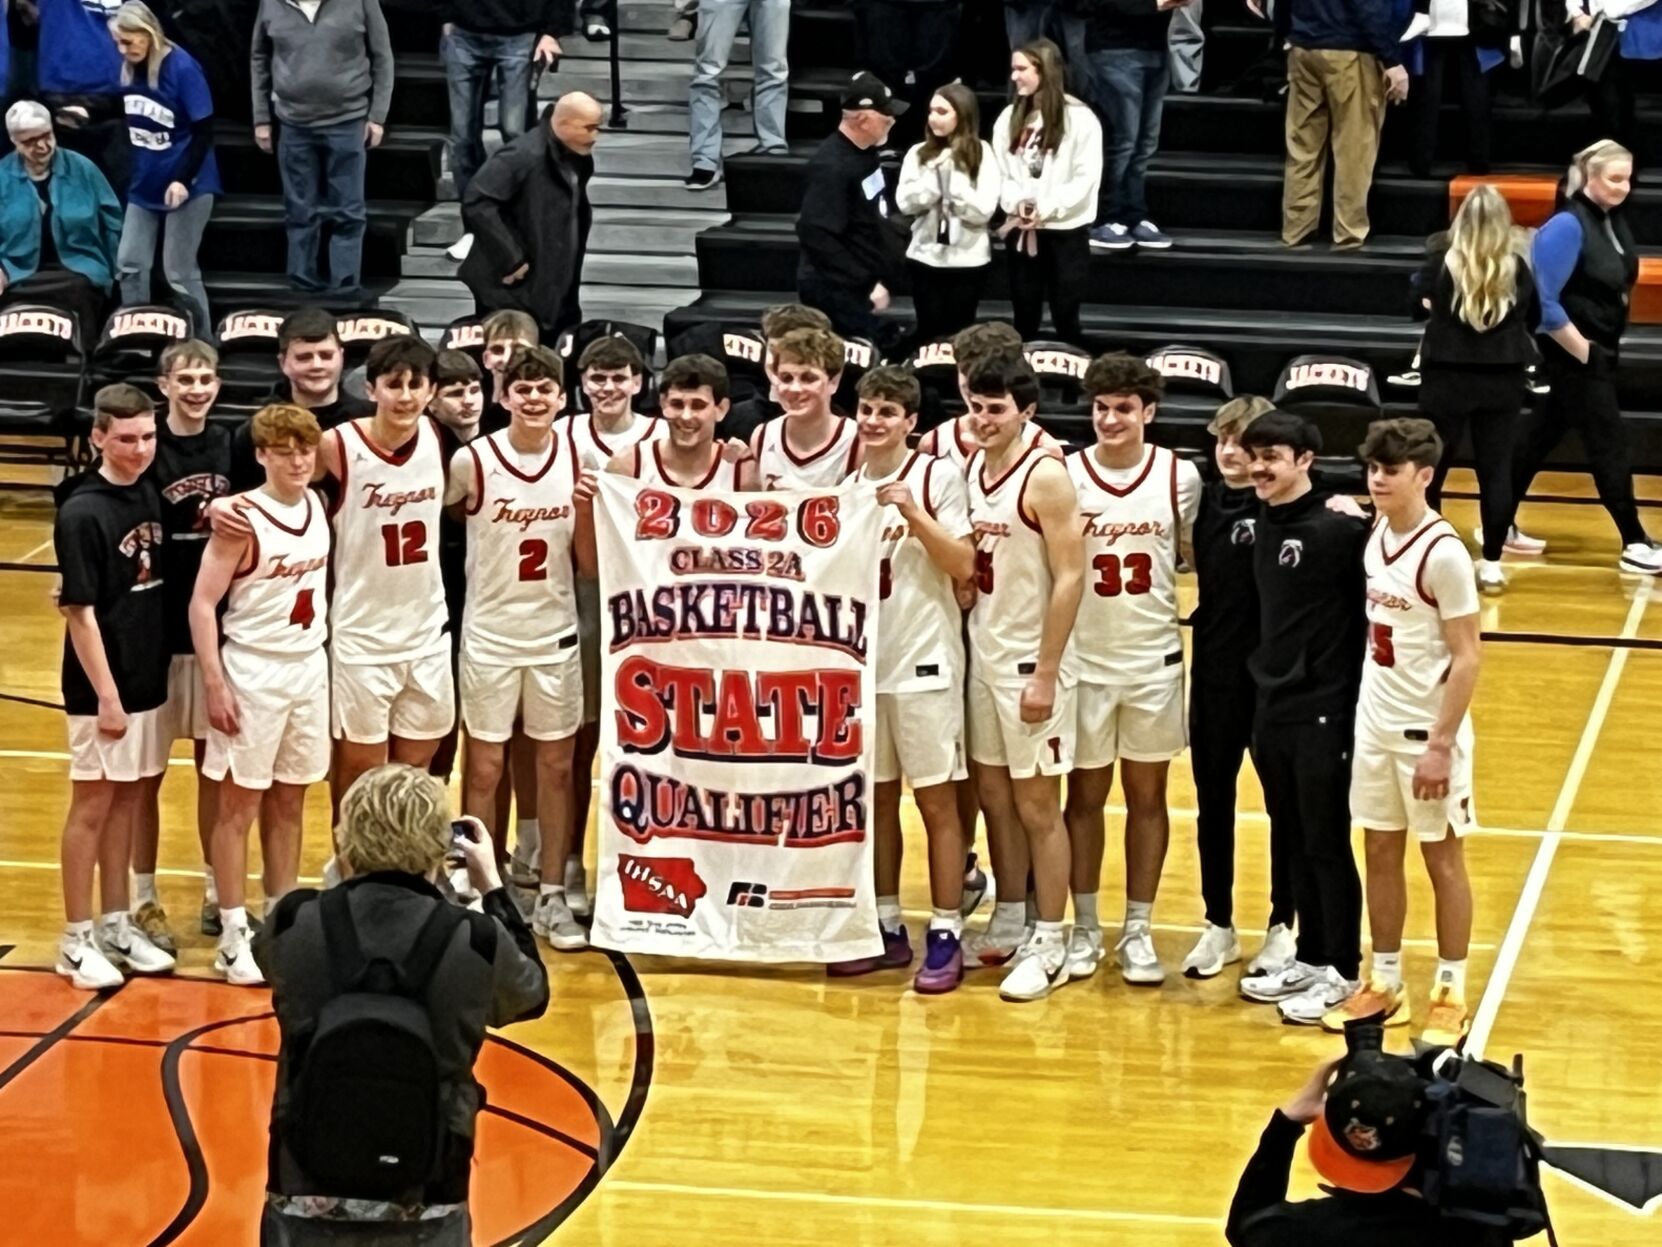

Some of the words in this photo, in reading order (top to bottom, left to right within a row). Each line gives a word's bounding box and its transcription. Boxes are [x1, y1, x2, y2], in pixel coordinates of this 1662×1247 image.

[634, 488, 841, 549] 2026
[381, 520, 428, 567] 12
[518, 538, 548, 581] 2
[669, 545, 766, 577] CLASS
[766, 550, 807, 583] 2A
[1092, 552, 1152, 597] 33
[290, 588, 315, 631] 4
[607, 580, 868, 666] BASKETBALL
[614, 655, 863, 767] STATE
[610, 763, 868, 848] QUALIFIER
[624, 858, 689, 910] IHSAA
